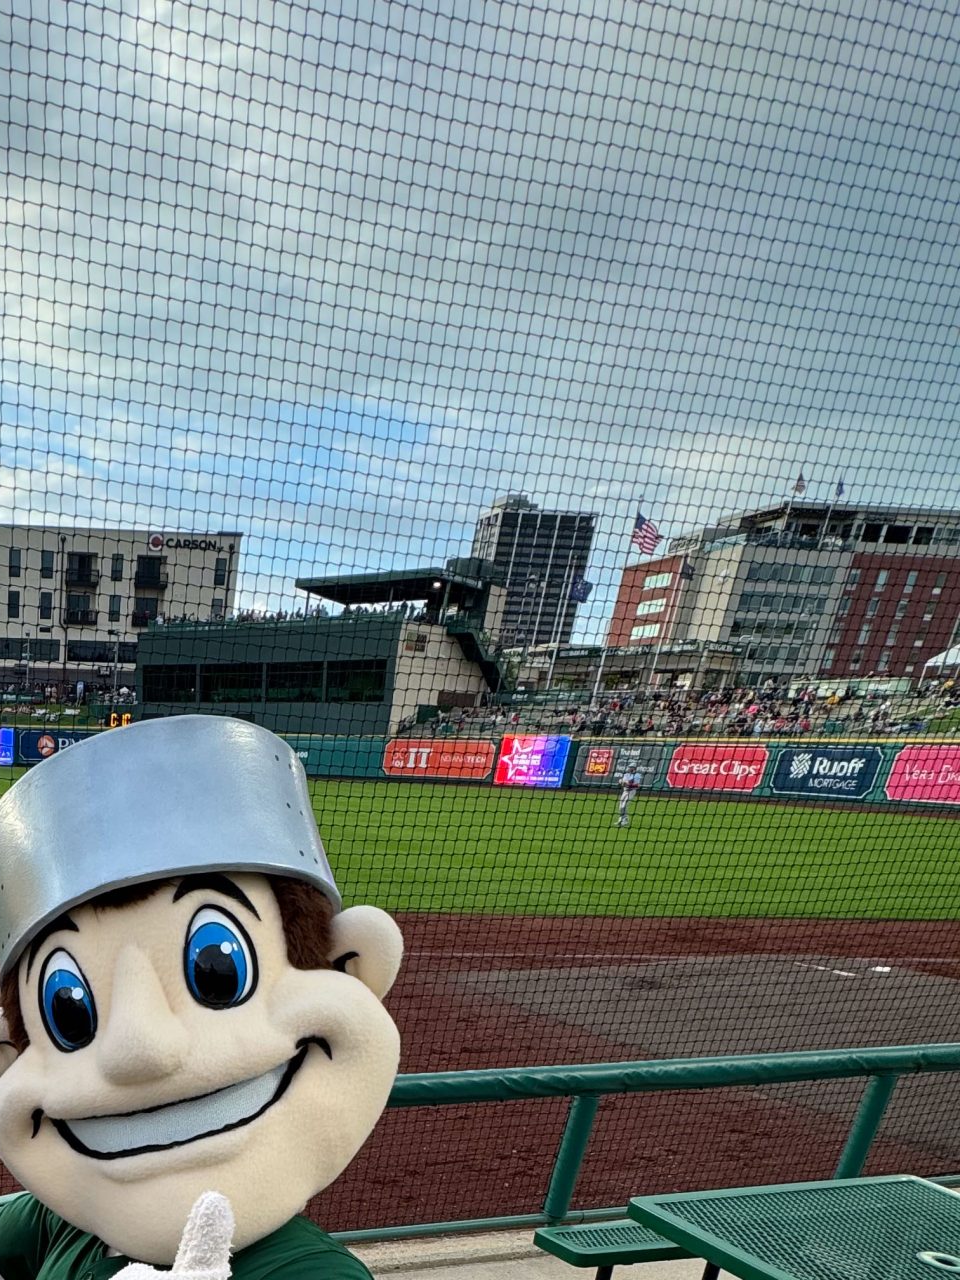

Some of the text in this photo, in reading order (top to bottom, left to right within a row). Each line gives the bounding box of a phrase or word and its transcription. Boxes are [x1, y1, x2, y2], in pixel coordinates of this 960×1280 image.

[165, 538, 218, 551] CARSON
[673, 759, 718, 776] Great
[812, 757, 868, 777] Ruoff
[808, 777, 859, 790] MORTGAGE
